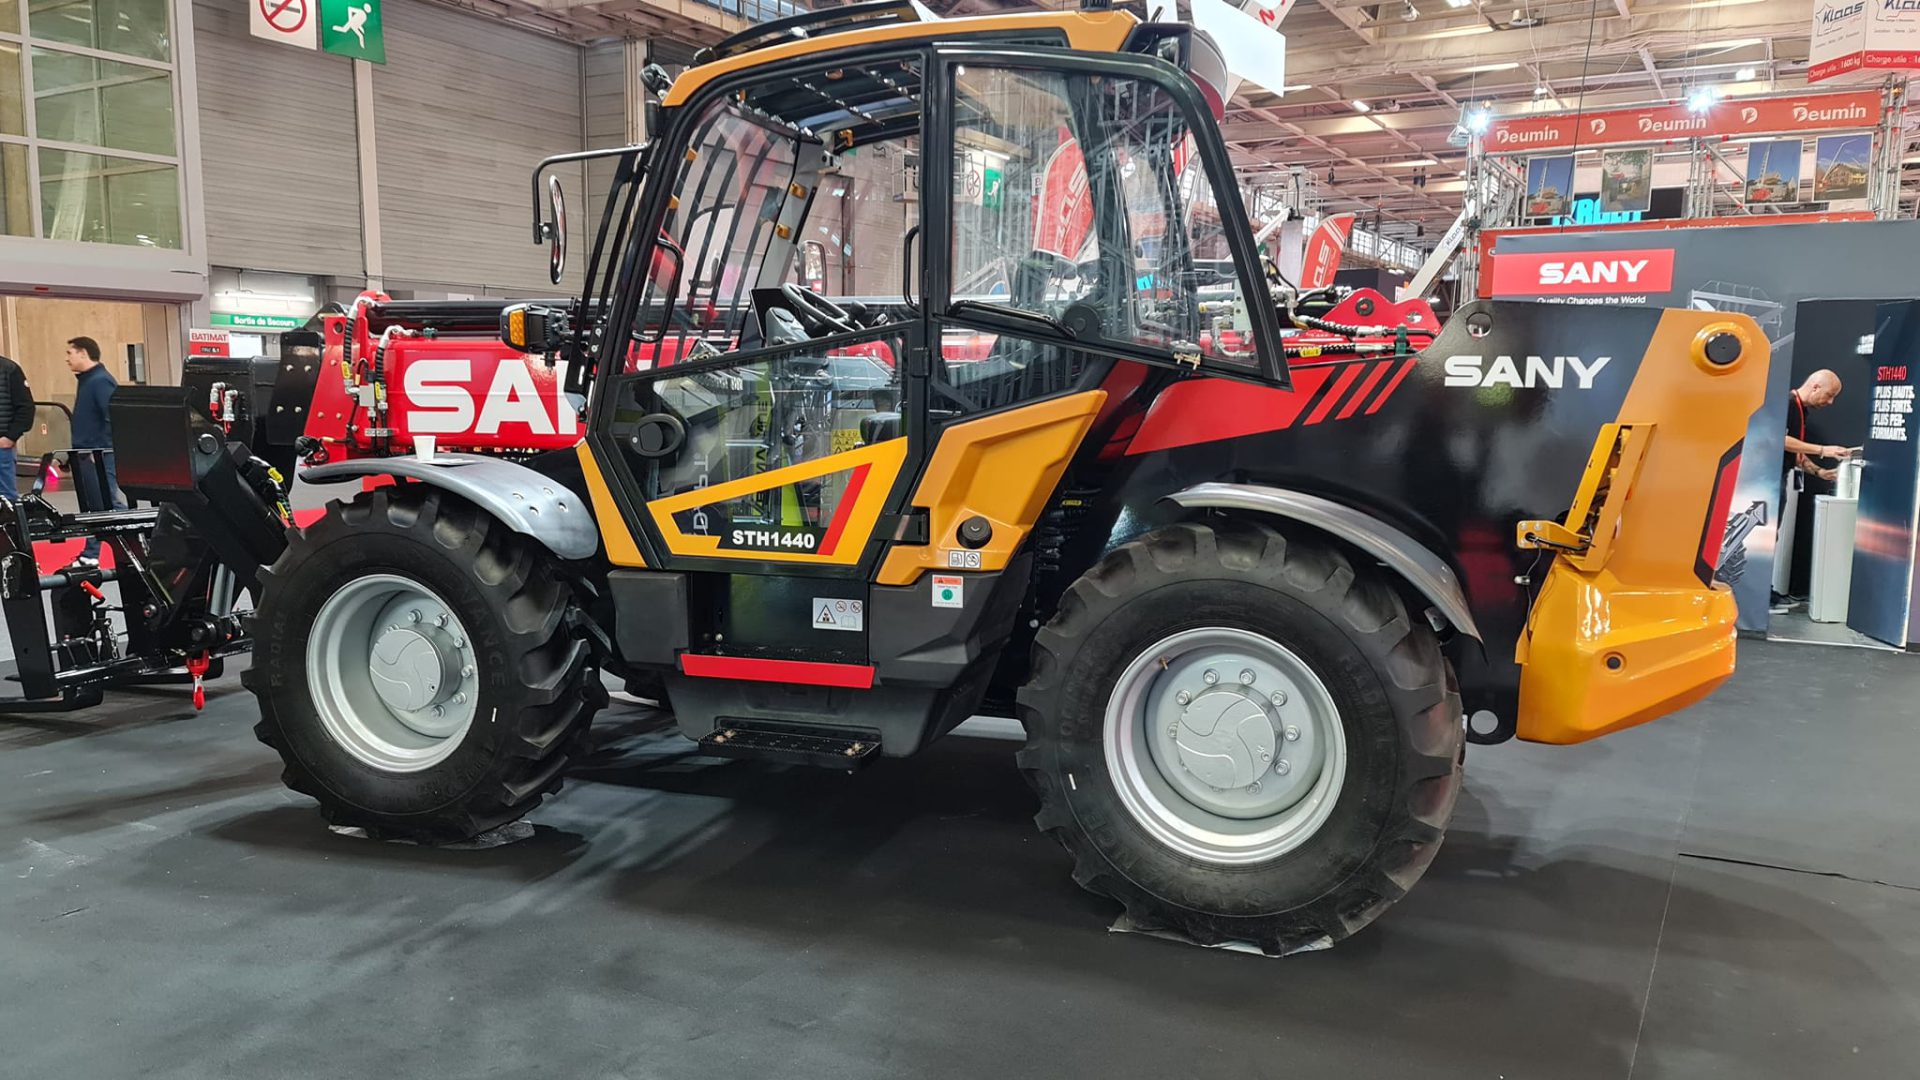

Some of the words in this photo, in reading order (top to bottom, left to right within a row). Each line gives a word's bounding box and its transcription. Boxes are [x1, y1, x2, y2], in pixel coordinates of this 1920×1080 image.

[1822, 2, 1865, 24] Klaas
[1866, 55, 1892, 65] Charge
[1539, 260, 1648, 284] SANY
[1566, 296, 1603, 305] Changes
[1605, 295, 1619, 304] the
[1620, 296, 1647, 304] World
[256, 317, 267, 326] de
[191, 332, 228, 342] BATIMAT
[1444, 355, 1612, 389] SANY
[1877, 366, 1907, 381] STH1440
[1875, 386, 1891, 399] PLUS
[1874, 399, 1890, 412] PLUS
[1872, 413, 1889, 426] PLUS
[1871, 427, 1907, 441] FORMANTS.
[732, 529, 815, 549] STH1440
